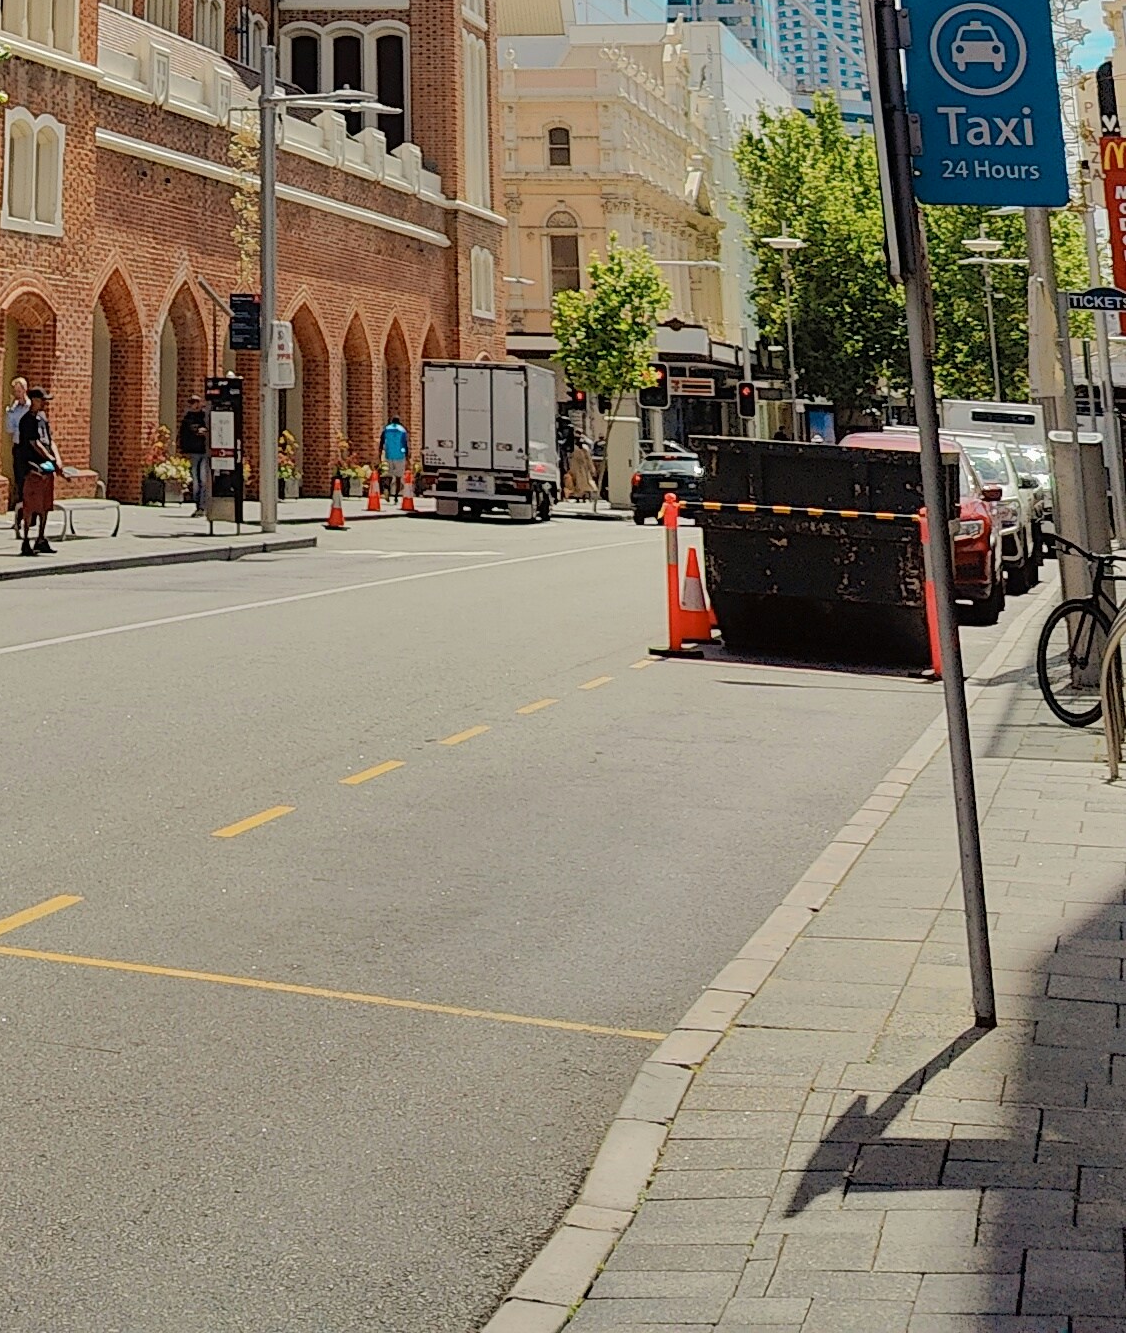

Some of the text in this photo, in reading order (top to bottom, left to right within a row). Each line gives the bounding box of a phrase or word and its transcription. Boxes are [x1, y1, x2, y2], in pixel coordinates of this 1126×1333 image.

[937, 107, 1034, 145] Taxi
[942, 160, 1040, 179] 24 Hours
